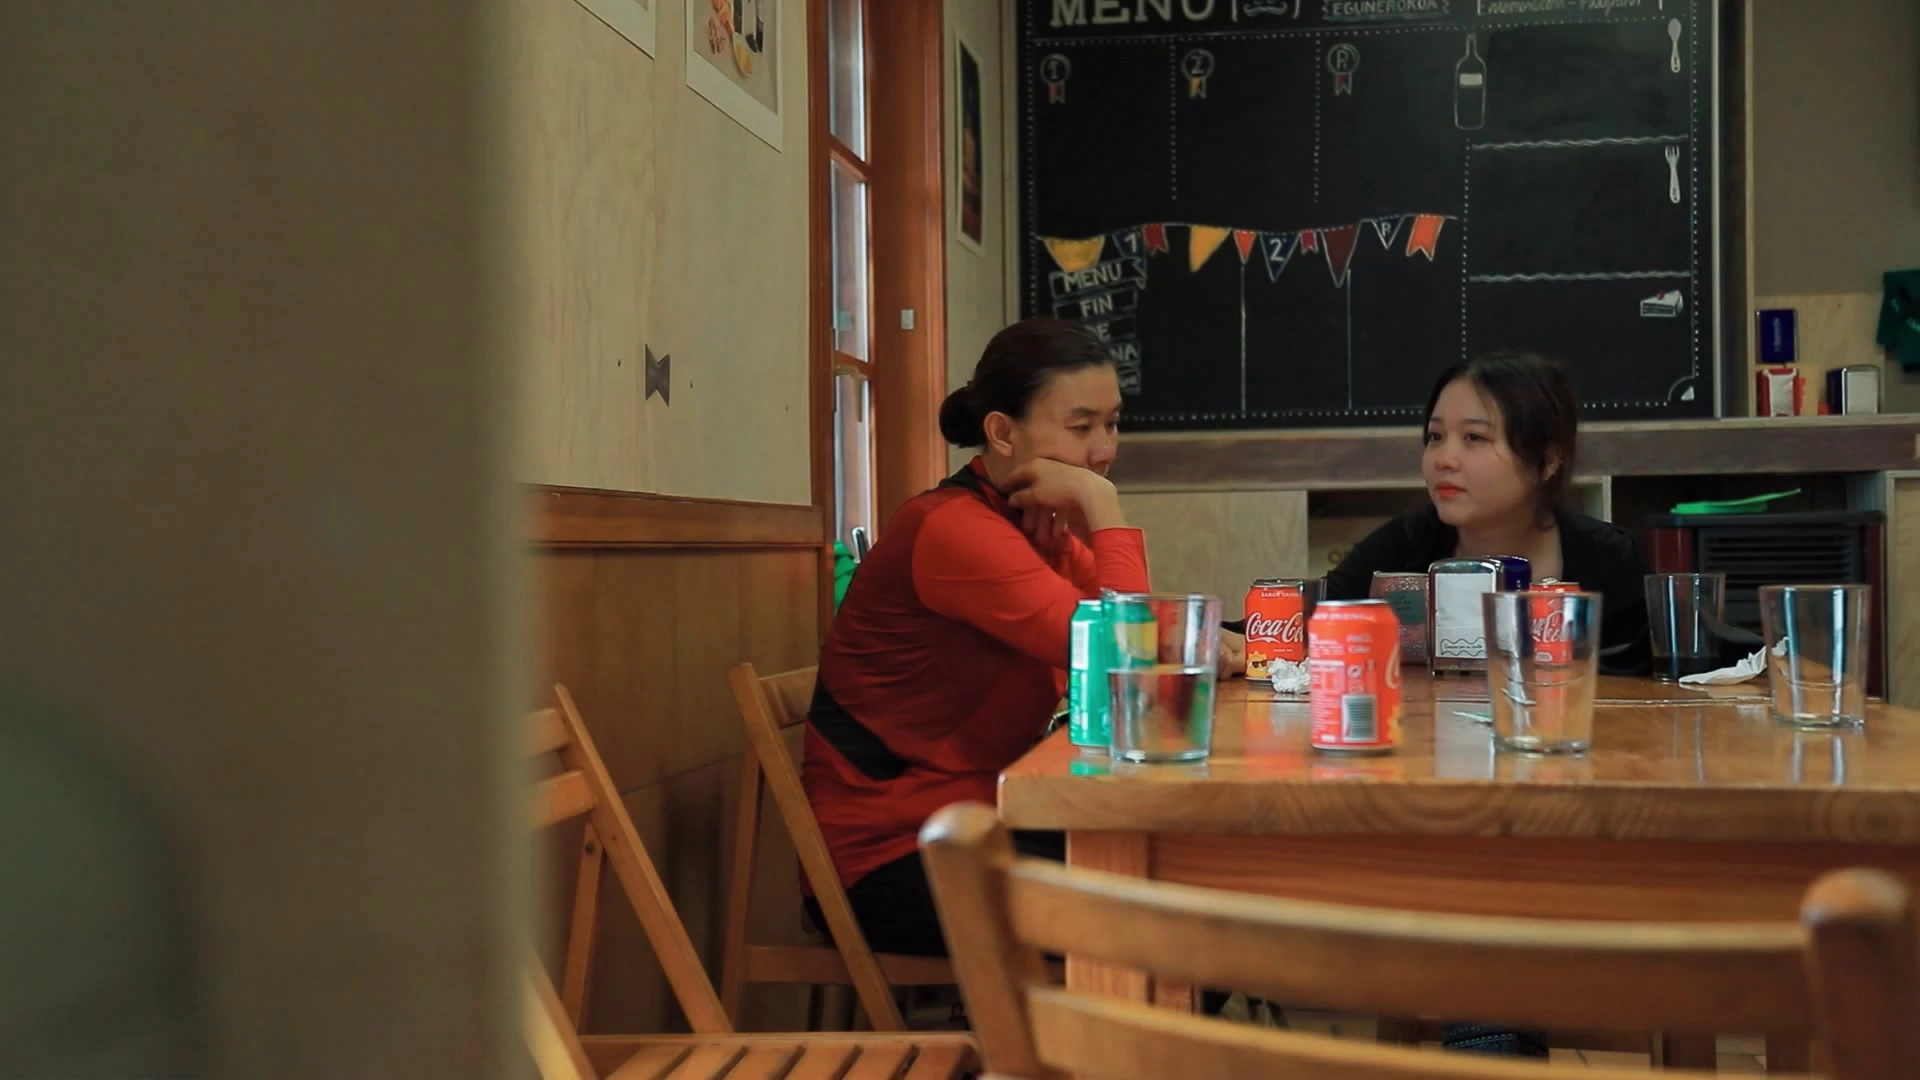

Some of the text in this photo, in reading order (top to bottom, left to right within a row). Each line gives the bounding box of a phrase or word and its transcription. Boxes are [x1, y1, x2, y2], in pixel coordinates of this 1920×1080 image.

[1191, 55, 1205, 74] 2
[1336, 50, 1349, 69] R
[1381, 222, 1391, 237] R
[1063, 263, 1123, 294] MENU
[1080, 294, 1115, 319] FIN
